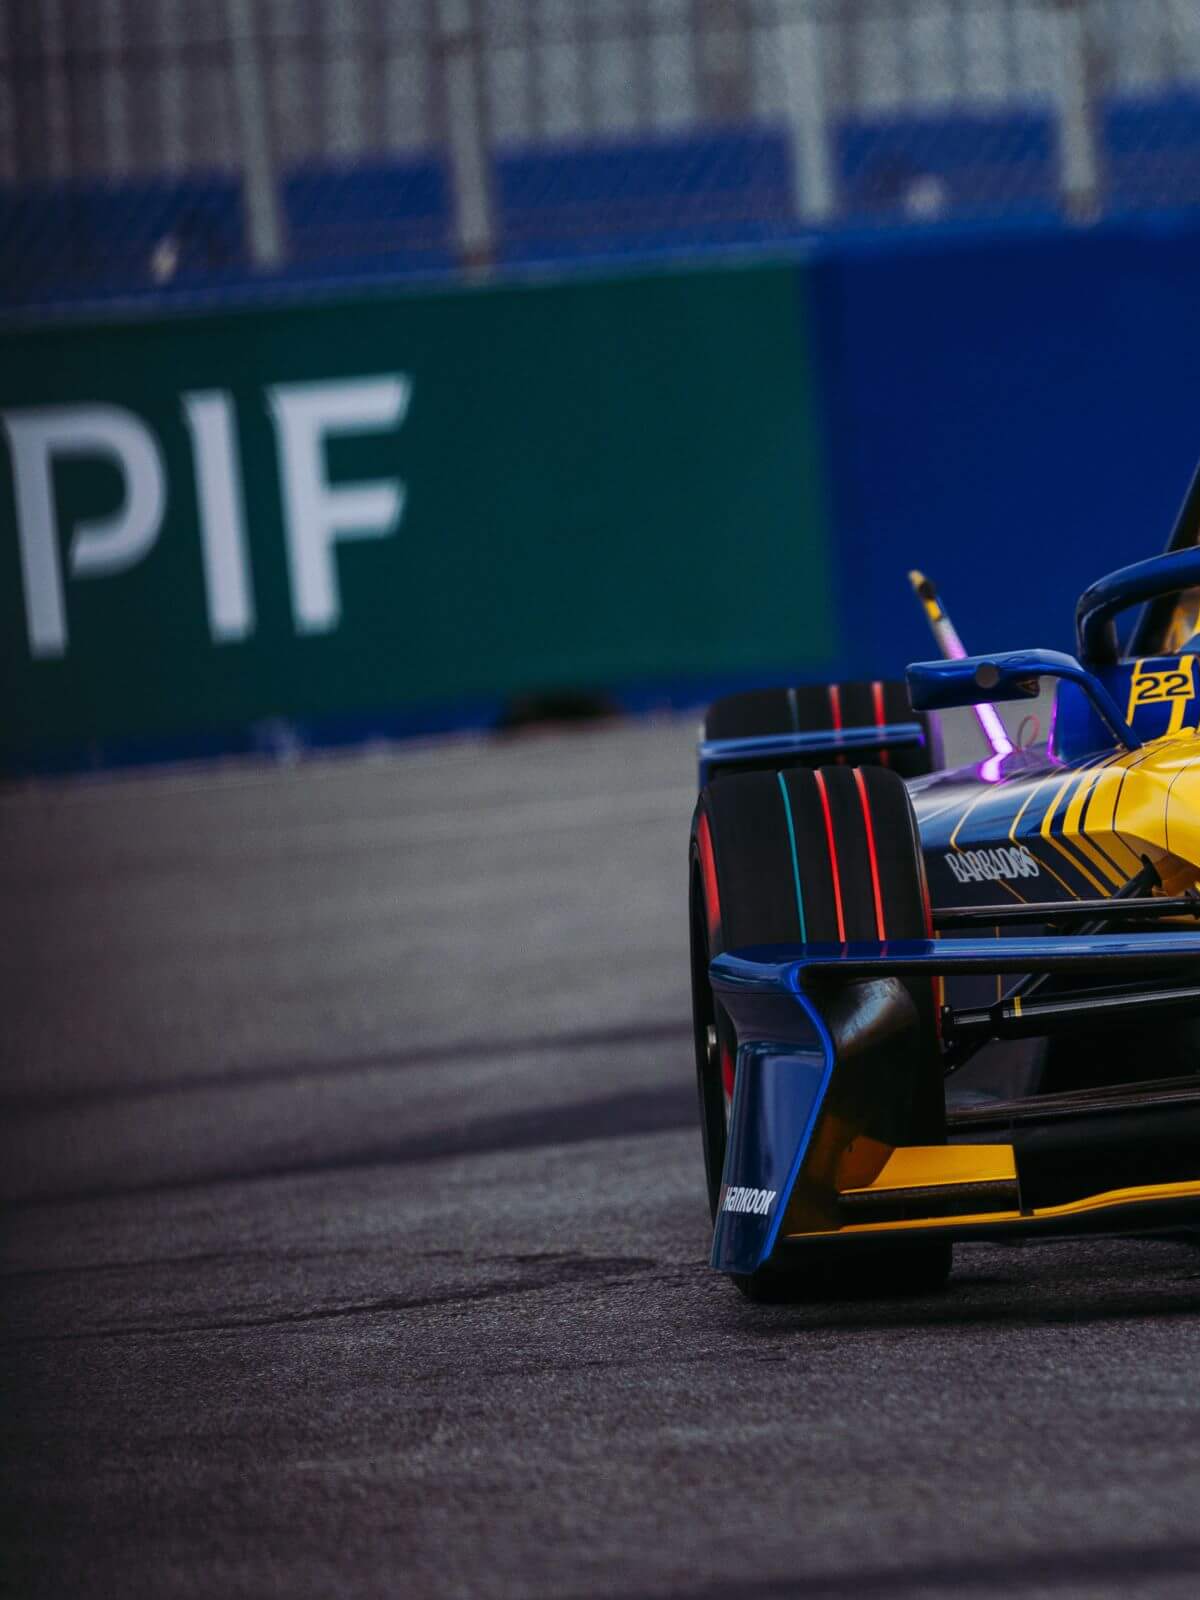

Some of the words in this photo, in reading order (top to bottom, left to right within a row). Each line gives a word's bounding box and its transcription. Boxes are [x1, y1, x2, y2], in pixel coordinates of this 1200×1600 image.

[3, 372, 412, 660] PIF
[1135, 673, 1191, 700] 22
[944, 845, 1039, 883] BARBADOS
